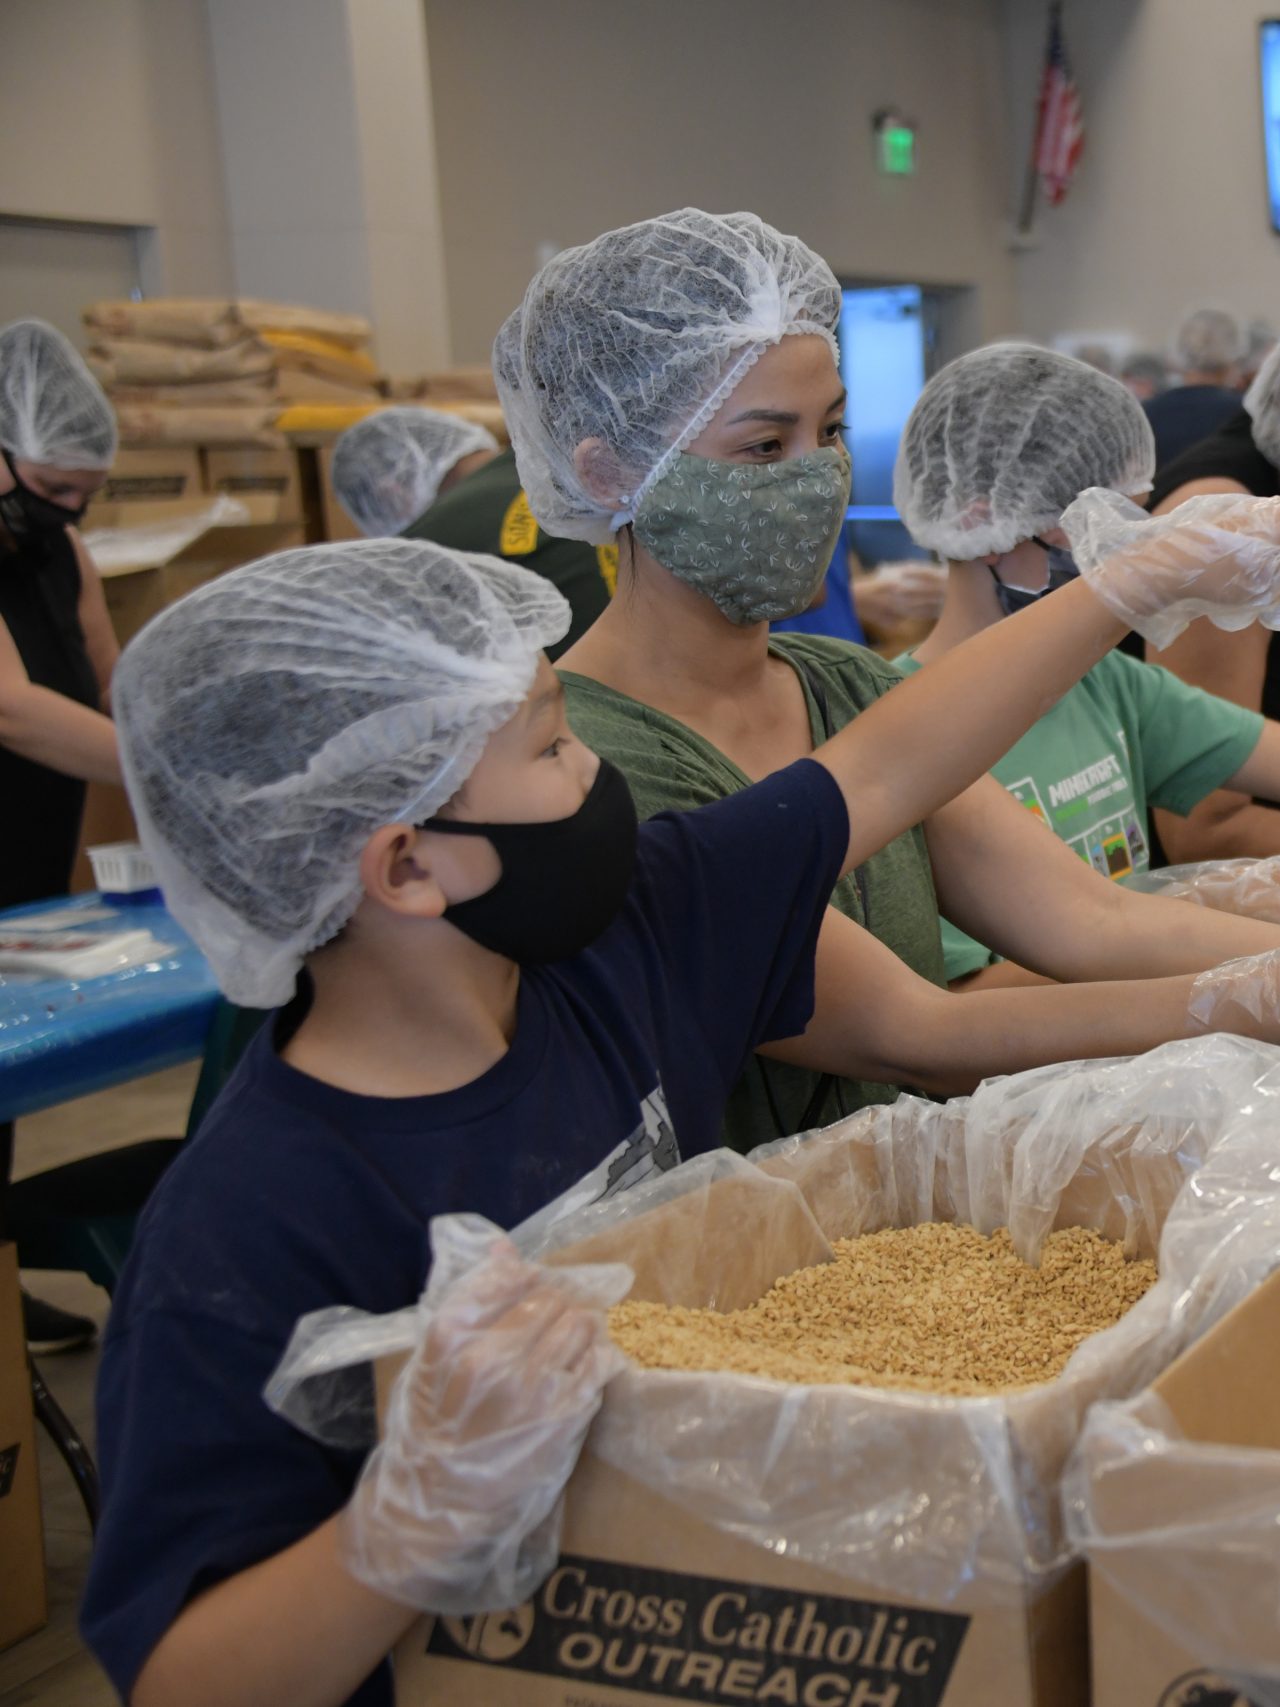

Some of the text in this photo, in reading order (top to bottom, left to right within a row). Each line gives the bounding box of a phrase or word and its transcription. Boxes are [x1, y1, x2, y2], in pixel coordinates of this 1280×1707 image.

[543, 1565, 937, 1677] Cross Catholic
[558, 1631, 901, 1707] OUTREACH
